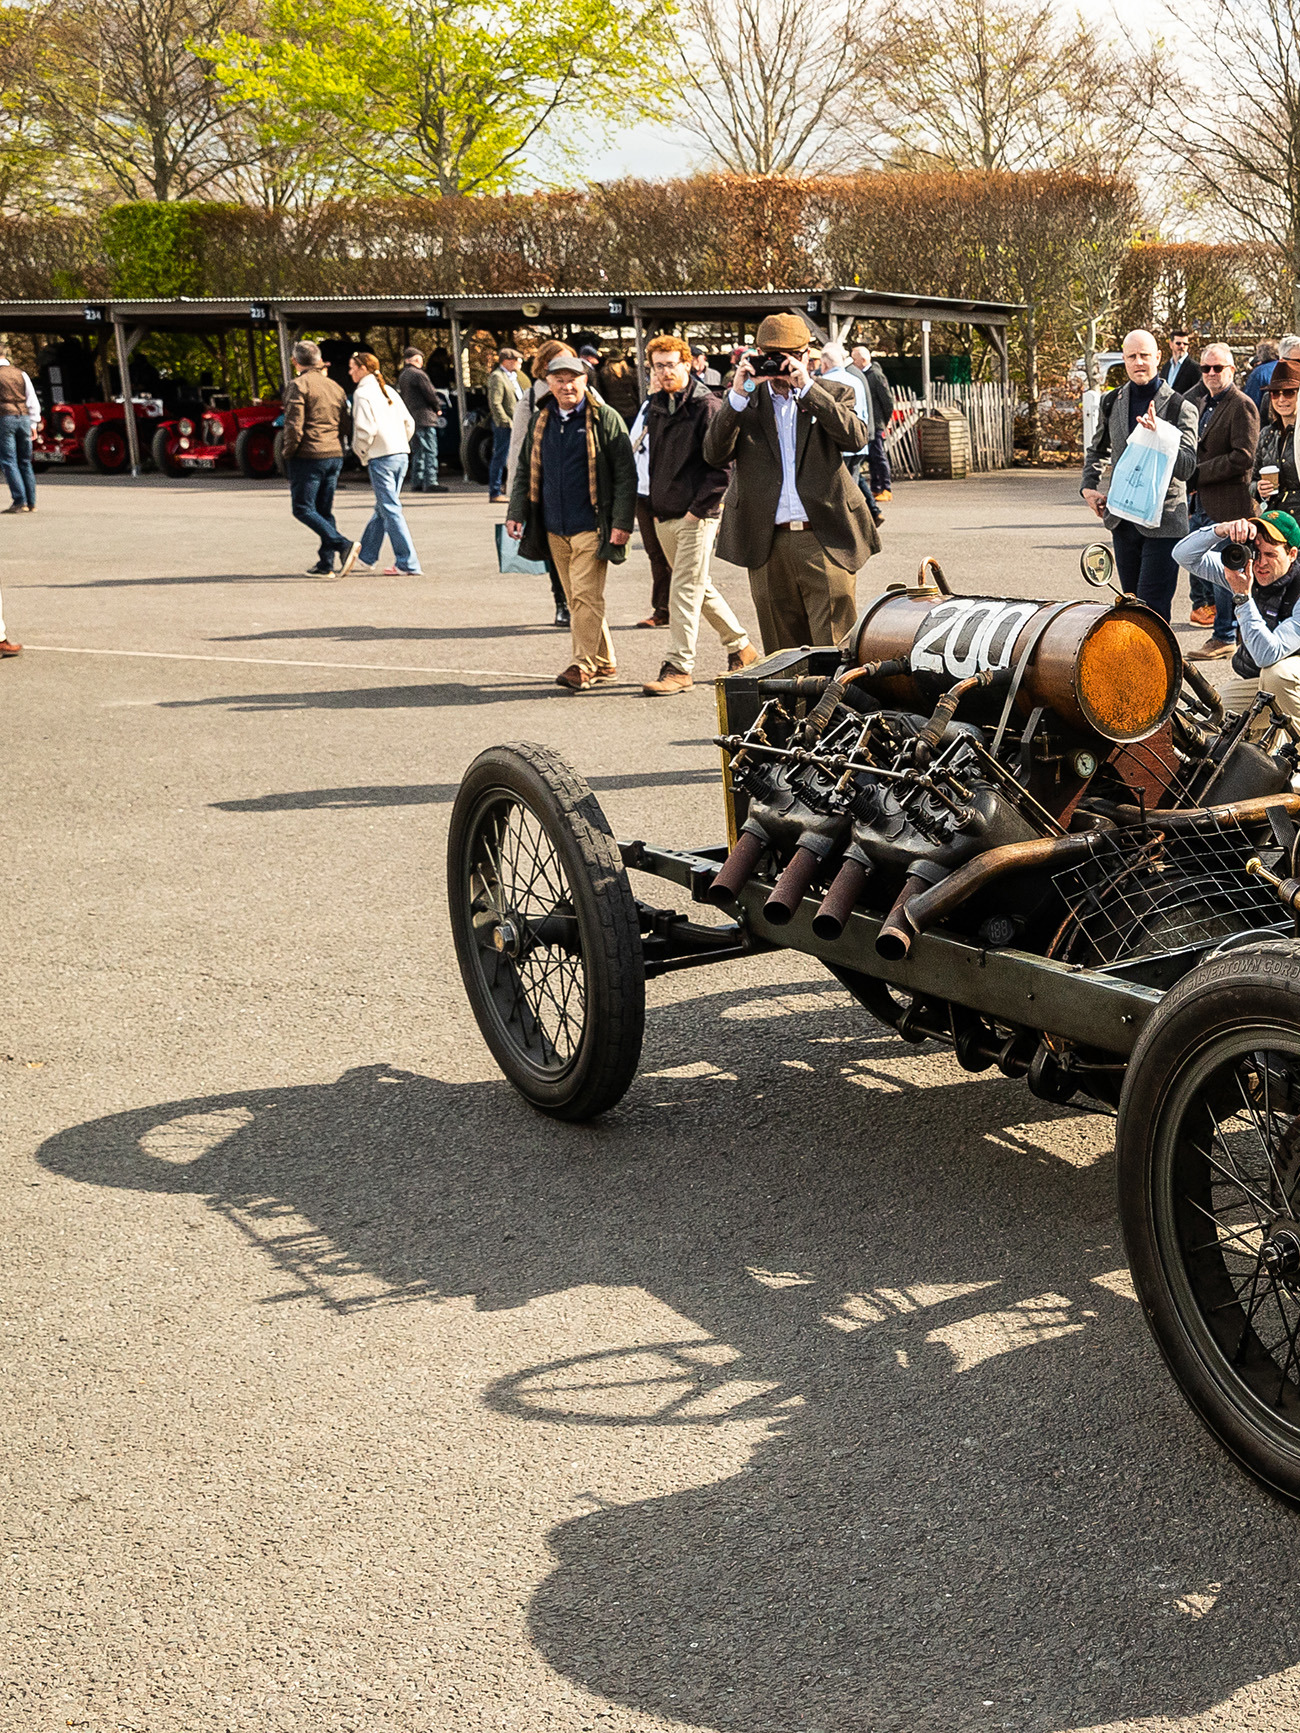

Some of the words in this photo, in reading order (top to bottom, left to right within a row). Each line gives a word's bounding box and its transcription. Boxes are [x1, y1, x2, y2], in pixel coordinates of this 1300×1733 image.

[250, 307, 266, 318] 235
[425, 306, 440, 317] 236
[910, 599, 1039, 680] 200
[1186, 959, 1262, 993] SILVERTOWN
[1263, 959, 1300, 979] CORD
